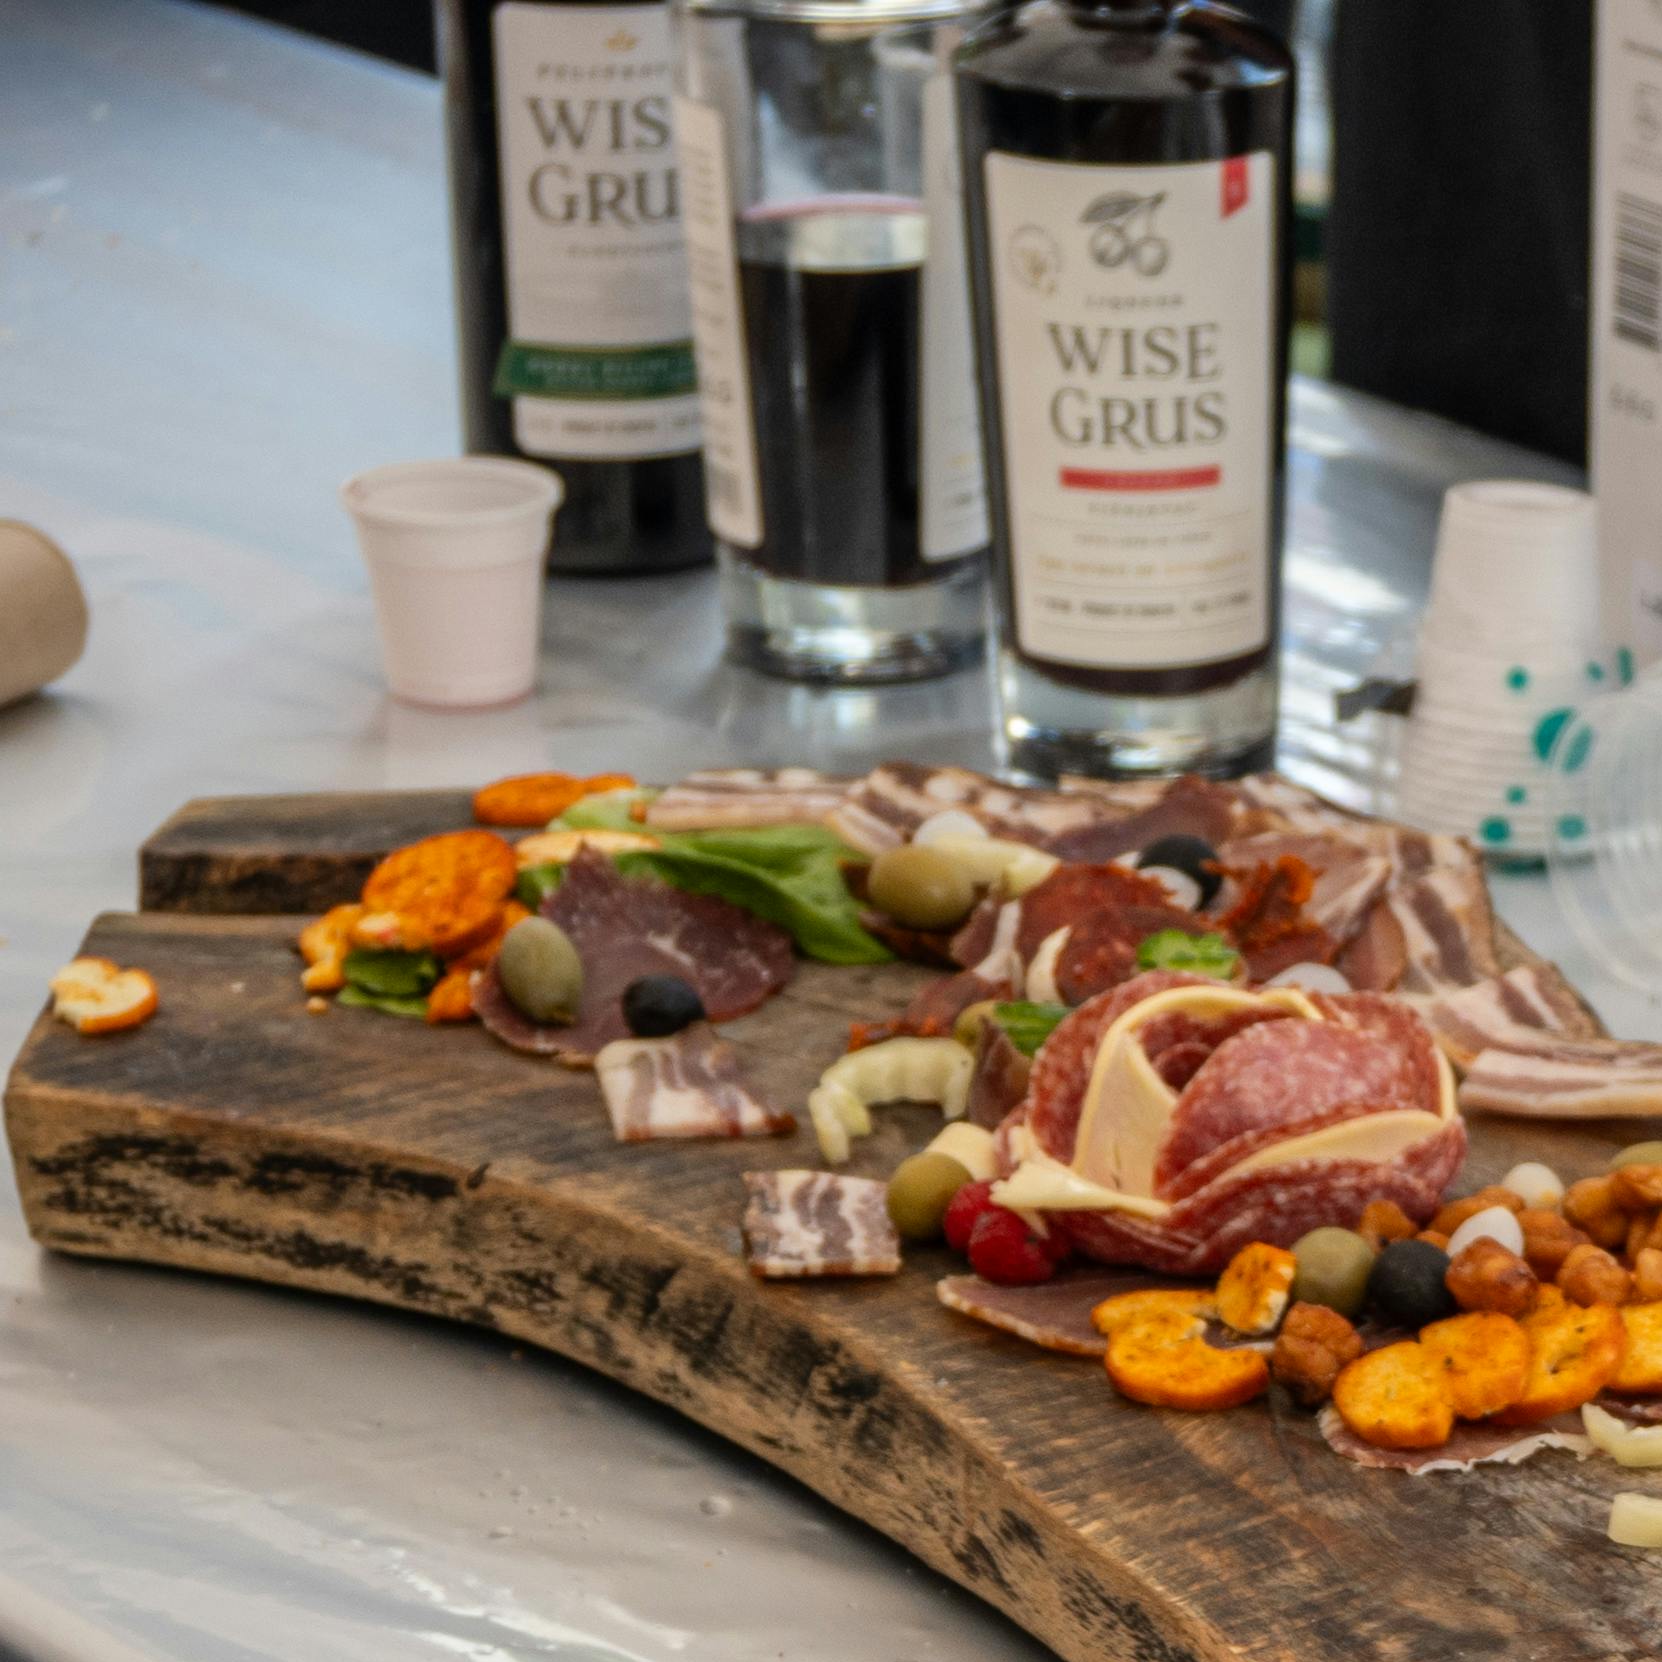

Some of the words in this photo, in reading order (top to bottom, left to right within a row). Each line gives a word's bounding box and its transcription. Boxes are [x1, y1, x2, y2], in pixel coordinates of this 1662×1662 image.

[524, 95, 671, 152] WIS
[528, 163, 681, 230] GRU
[1046, 322, 1222, 384] WISE
[1050, 386, 1229, 455] GRUS
